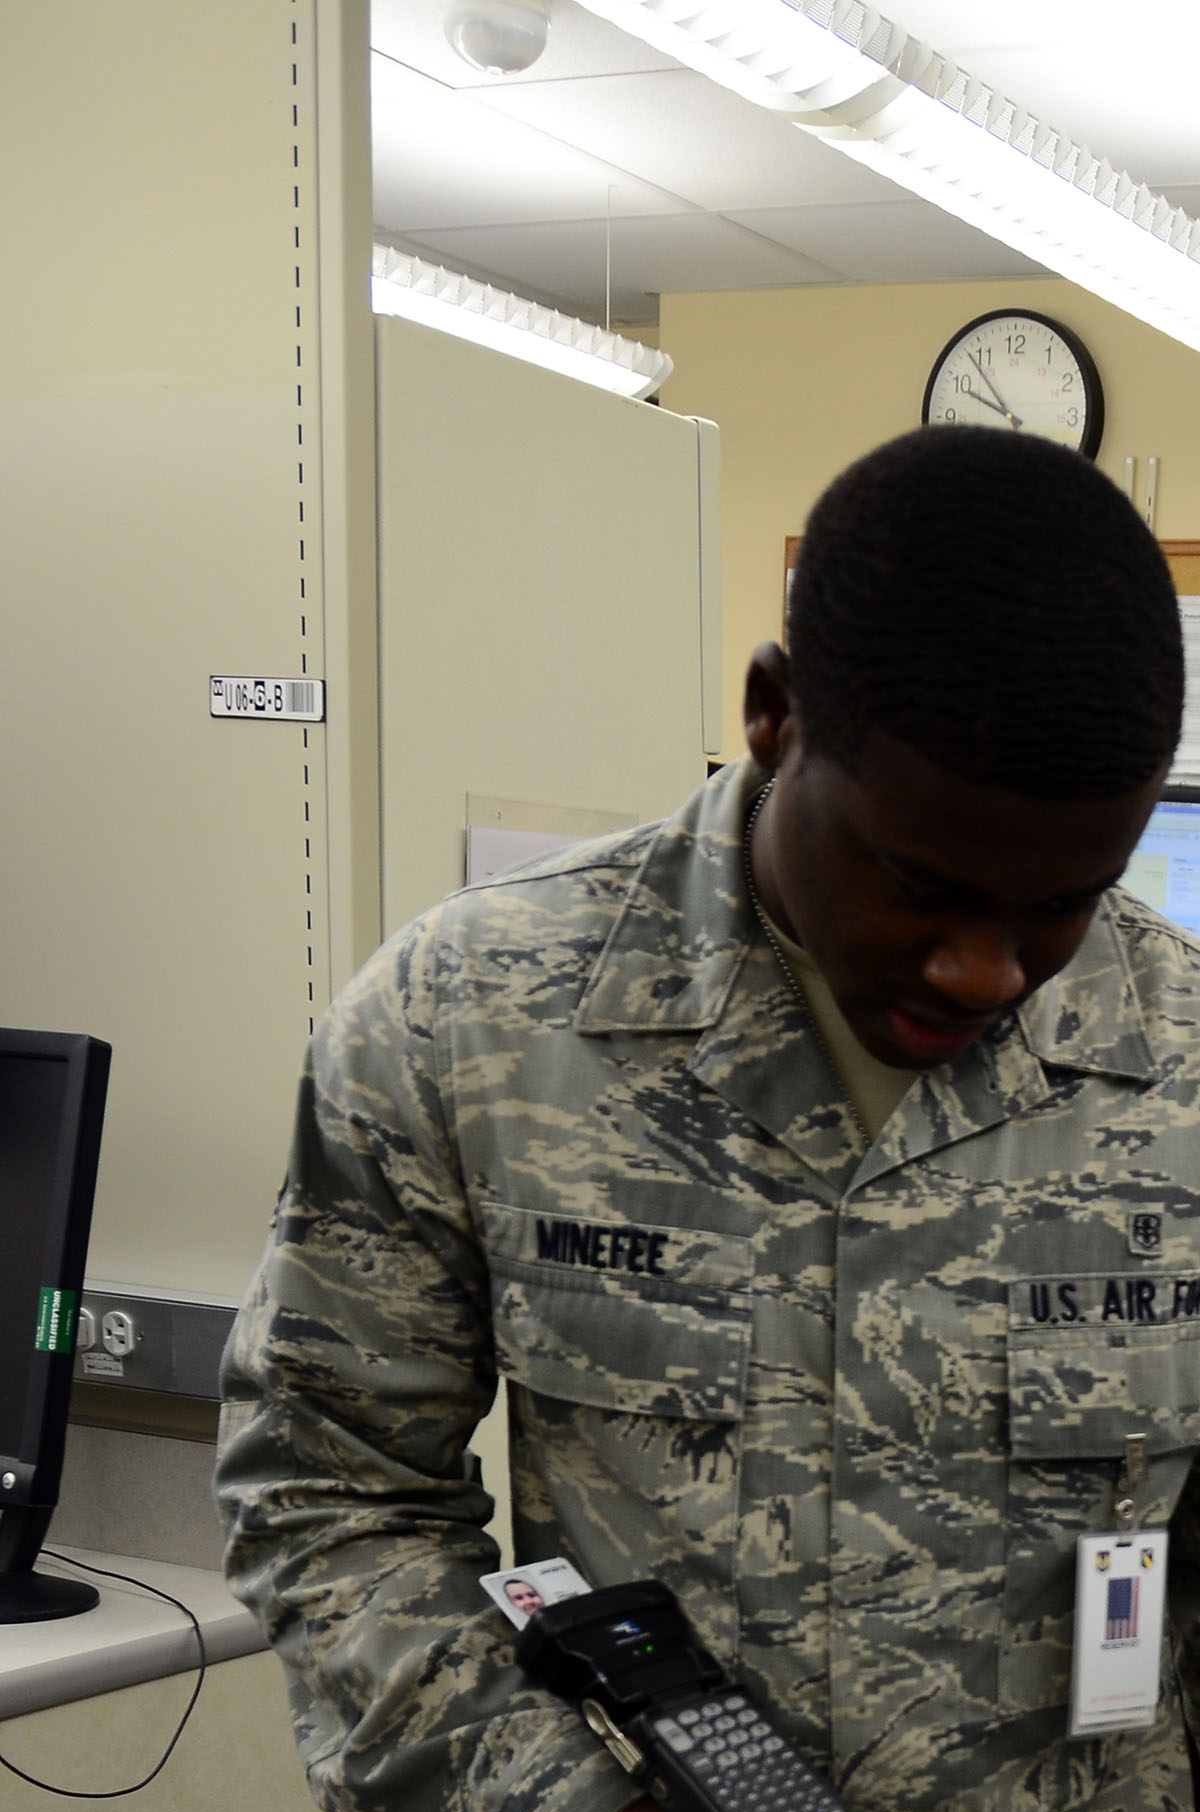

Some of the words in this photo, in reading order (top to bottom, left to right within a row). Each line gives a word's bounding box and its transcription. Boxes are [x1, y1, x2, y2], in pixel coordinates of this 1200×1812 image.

[1005, 334, 1026, 354] 12
[976, 347, 992, 366] 11
[1045, 346, 1051, 365] 1
[953, 374, 972, 393] 10
[1062, 372, 1073, 392] 2
[945, 408, 956, 425] 9
[1067, 407, 1078, 427] 3
[536, 1218, 668, 1275] MINEFEE
[1030, 1283, 1087, 1324] U.S.
[1102, 1279, 1156, 1322] AIR
[48, 1290, 61, 1350] UNCLASSIFIED
